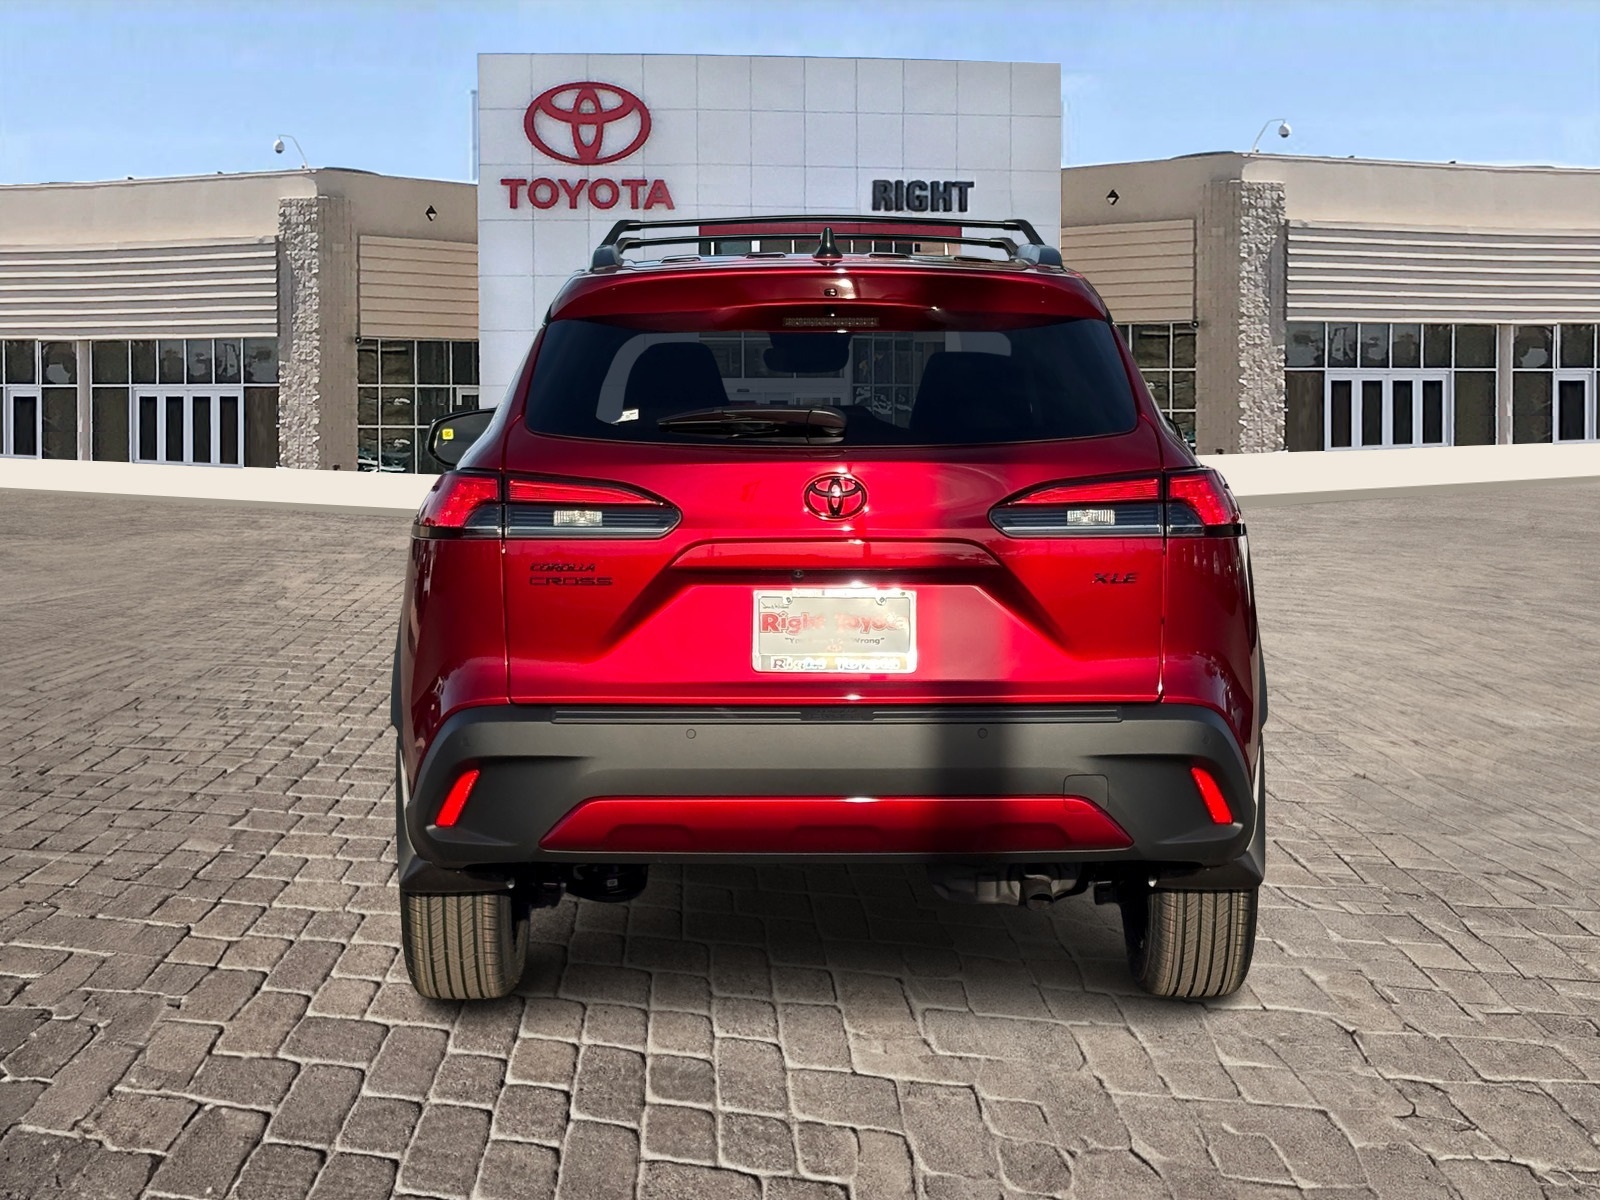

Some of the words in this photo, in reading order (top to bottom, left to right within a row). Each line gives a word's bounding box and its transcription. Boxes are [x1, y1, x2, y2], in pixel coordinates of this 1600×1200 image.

[500, 177, 675, 210] TOYOTA
[872, 179, 975, 212] RIGHT
[530, 563, 595, 572] COROLLA
[529, 577, 613, 586] CROSS
[1094, 573, 1137, 584] XLE
[835, 611, 909, 634] Toyoa
